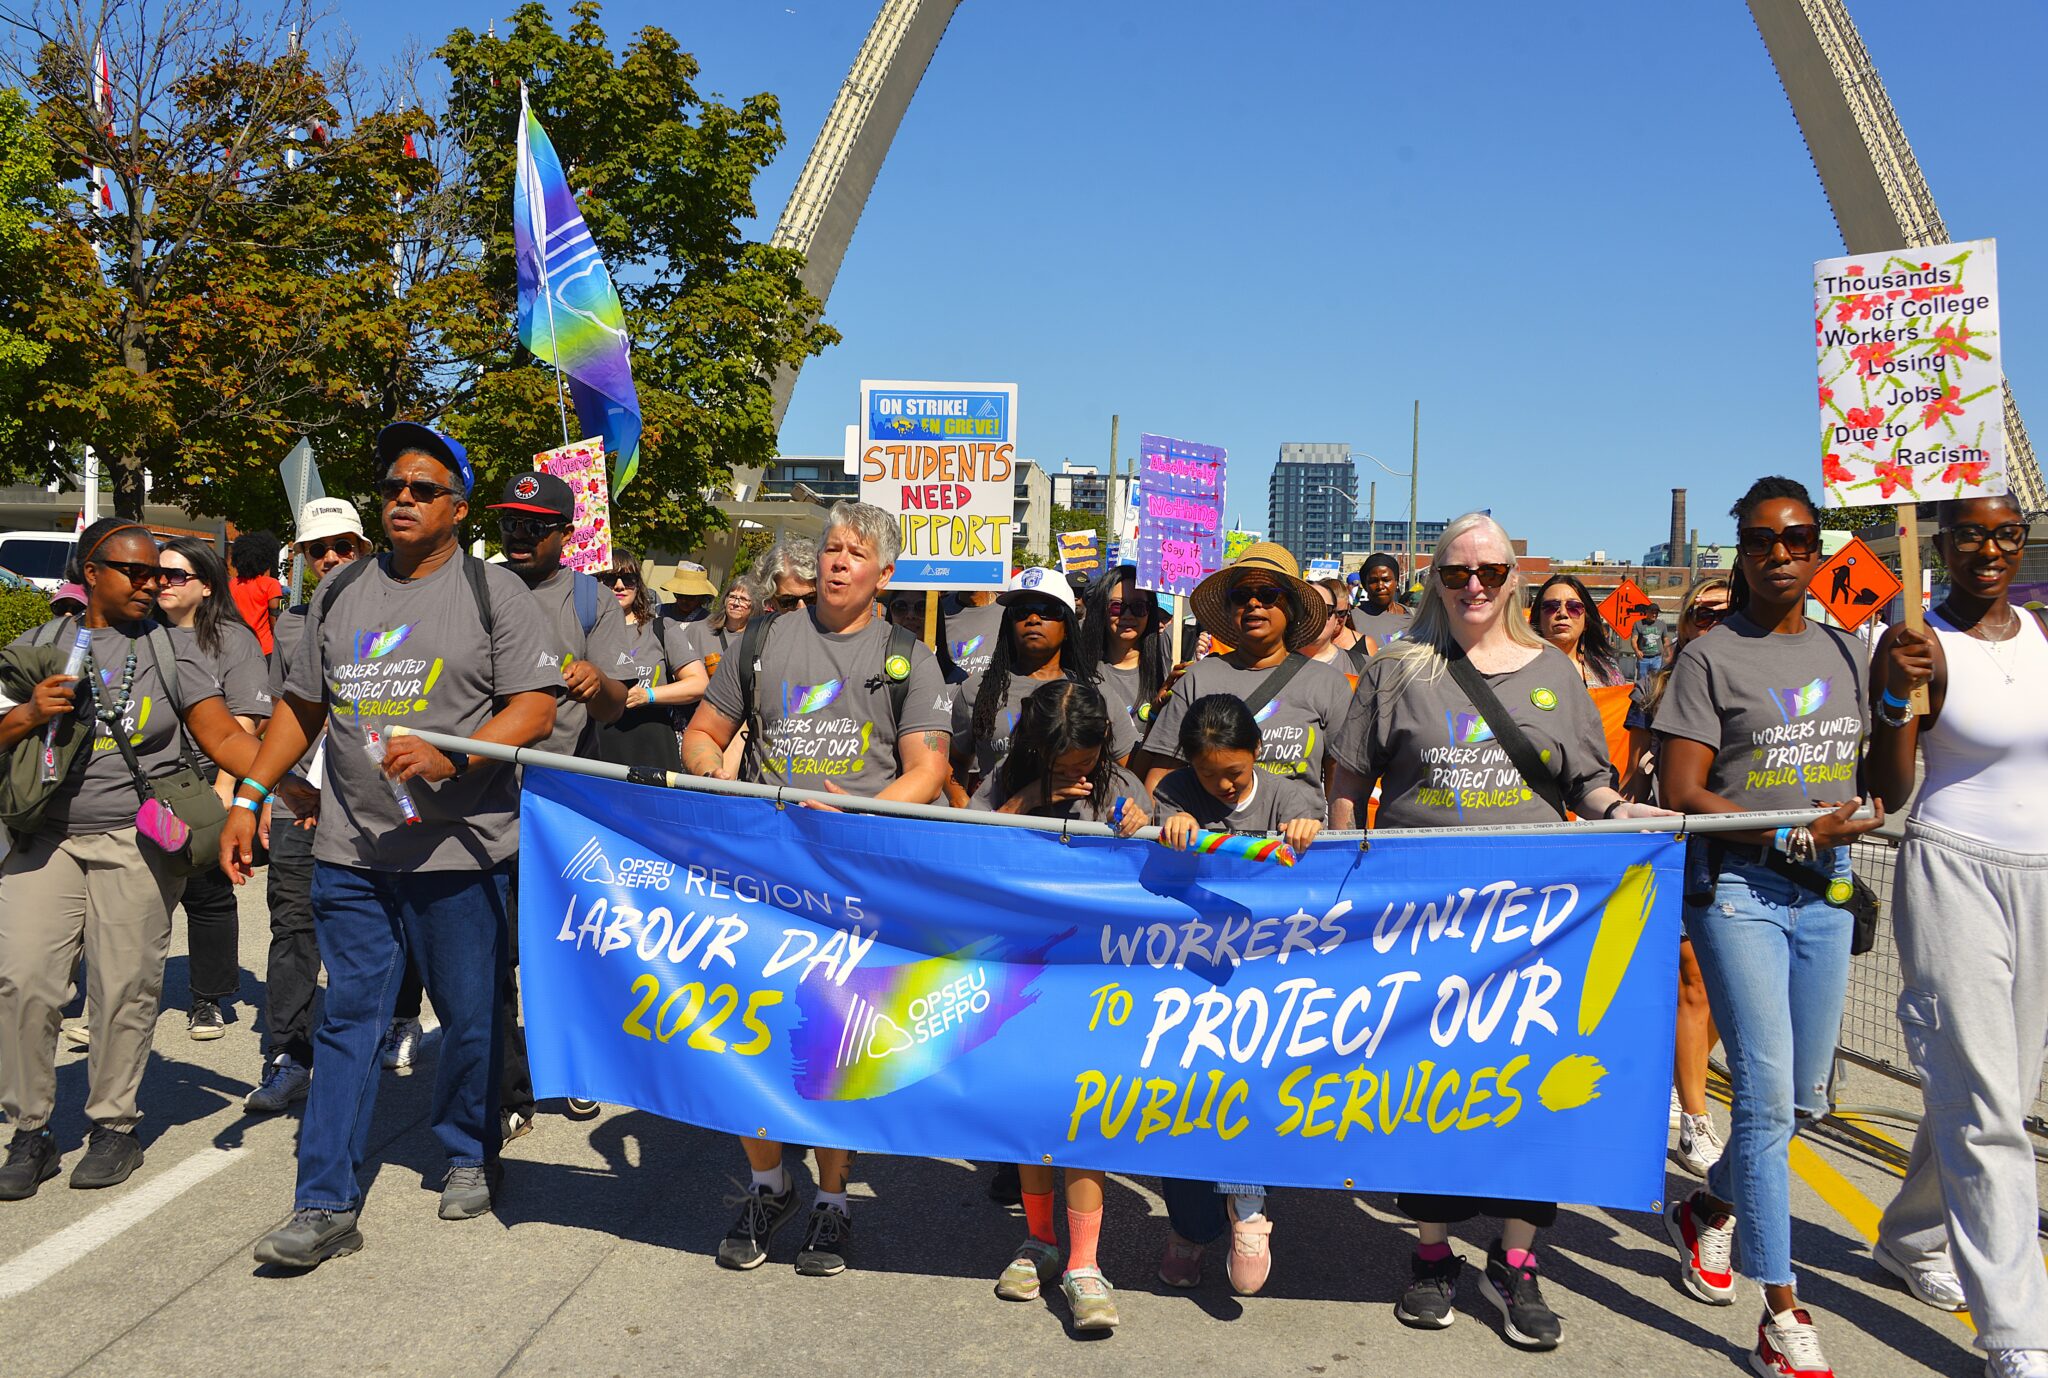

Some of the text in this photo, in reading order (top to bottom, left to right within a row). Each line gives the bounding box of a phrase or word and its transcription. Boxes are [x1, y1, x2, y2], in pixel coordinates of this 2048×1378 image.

[1824, 267, 1951, 294] Thousands
[1872, 296, 1989, 321] of College
[1825, 327, 1919, 346] Workers
[1868, 355, 1945, 375] Losing
[1887, 386, 1943, 406] Jobs
[880, 399, 968, 415] ON STRIKE!
[921, 416, 999, 434] EN GRÈVE!
[1836, 424, 1908, 443] Due to
[548, 456, 592, 475] Where
[863, 443, 1014, 482] STUDENTS
[1897, 448, 1989, 465] Racism.
[902, 484, 972, 510] NEED
[1149, 496, 1218, 530] Nothing
[1161, 540, 1201, 559] (say it
[1162, 557, 1202, 582] again)
[333, 659, 426, 679] WORKERS UNITED
[338, 679, 391, 700] PROTECT
[392, 680, 422, 697] OUR
[358, 698, 412, 716] SERVICES
[766, 719, 812, 735] WORKERS
[1262, 726, 1303, 741] UNITED
[1752, 716, 1861, 745] WORKERS UNITED
[769, 737, 860, 758] PROTECT OUR
[1275, 743, 1302, 760] OUR
[1421, 747, 1477, 765] WORKERS
[1766, 740, 1833, 769] PROTECT
[791, 757, 850, 775] SERVICES
[1432, 767, 1494, 790] PROTECT
[1745, 766, 1798, 790] PUBLIC
[1415, 788, 1519, 808] PUBLIC SERVICES
[615, 874, 670, 891] SEFPO
[619, 857, 865, 920] OPSEU REGION 5
[1100, 880, 1579, 970] WORKERS UNITED
[556, 894, 879, 987] LABOUR DAY
[908, 966, 986, 1021] OPSEU
[622, 973, 784, 1056] 2025
[915, 989, 990, 1044] SEFPO
[1088, 957, 1563, 1069] TO PROTECT OUR
[1067, 1054, 1531, 1143] PUBLIC SERVICES
